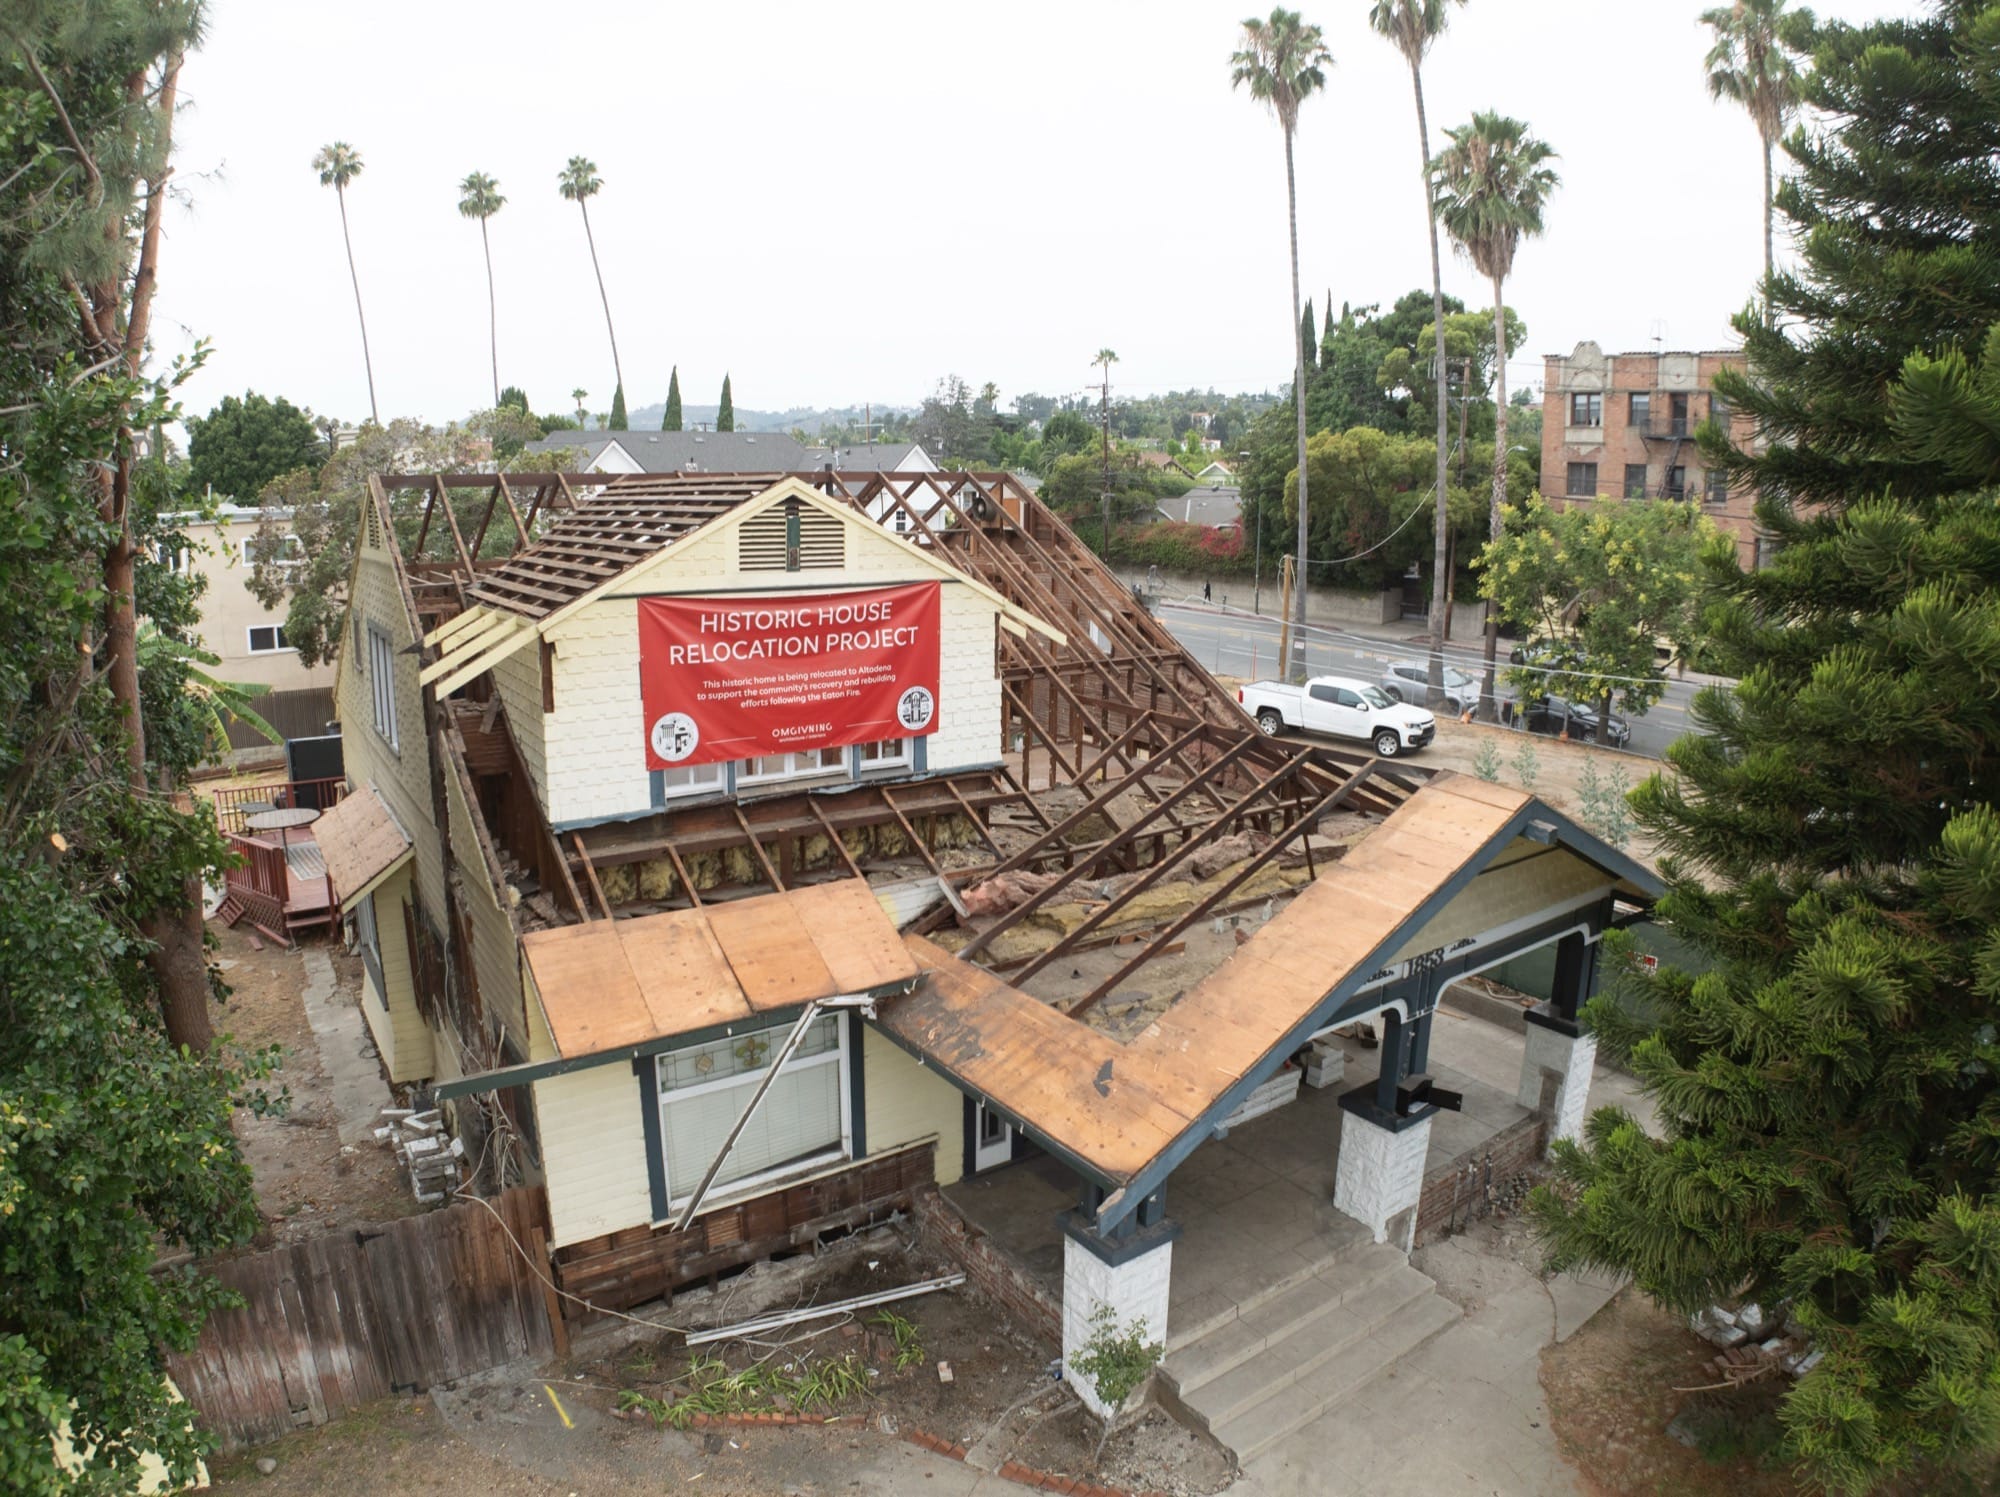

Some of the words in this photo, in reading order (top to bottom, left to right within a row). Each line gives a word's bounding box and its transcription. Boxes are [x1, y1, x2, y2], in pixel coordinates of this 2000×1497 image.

[701, 609, 811, 633] HISTORIC
[818, 602, 892, 626] HOUSE
[670, 635, 819, 665] RELOCATION
[826, 626, 918, 652] PROJECT
[697, 693, 706, 701] to
[708, 690, 742, 700] support
[759, 682, 808, 695] community's
[810, 681, 843, 690] recovery
[844, 678, 859, 686] and
[861, 674, 896, 685] rebuilding
[703, 680, 720, 689] This
[722, 677, 752, 687] historic
[754, 676, 776, 684] home
[778, 674, 785, 682] is
[786, 673, 808, 681] being
[810, 667, 847, 678] relocated
[848, 667, 857, 675] to
[858, 664, 891, 673] Altadena
[740, 699, 768, 708] efforts
[770, 695, 806, 706] following
[808, 693, 821, 701] the
[823, 691, 844, 700] Eaton
[771, 722, 833, 738] OMGIVNING
